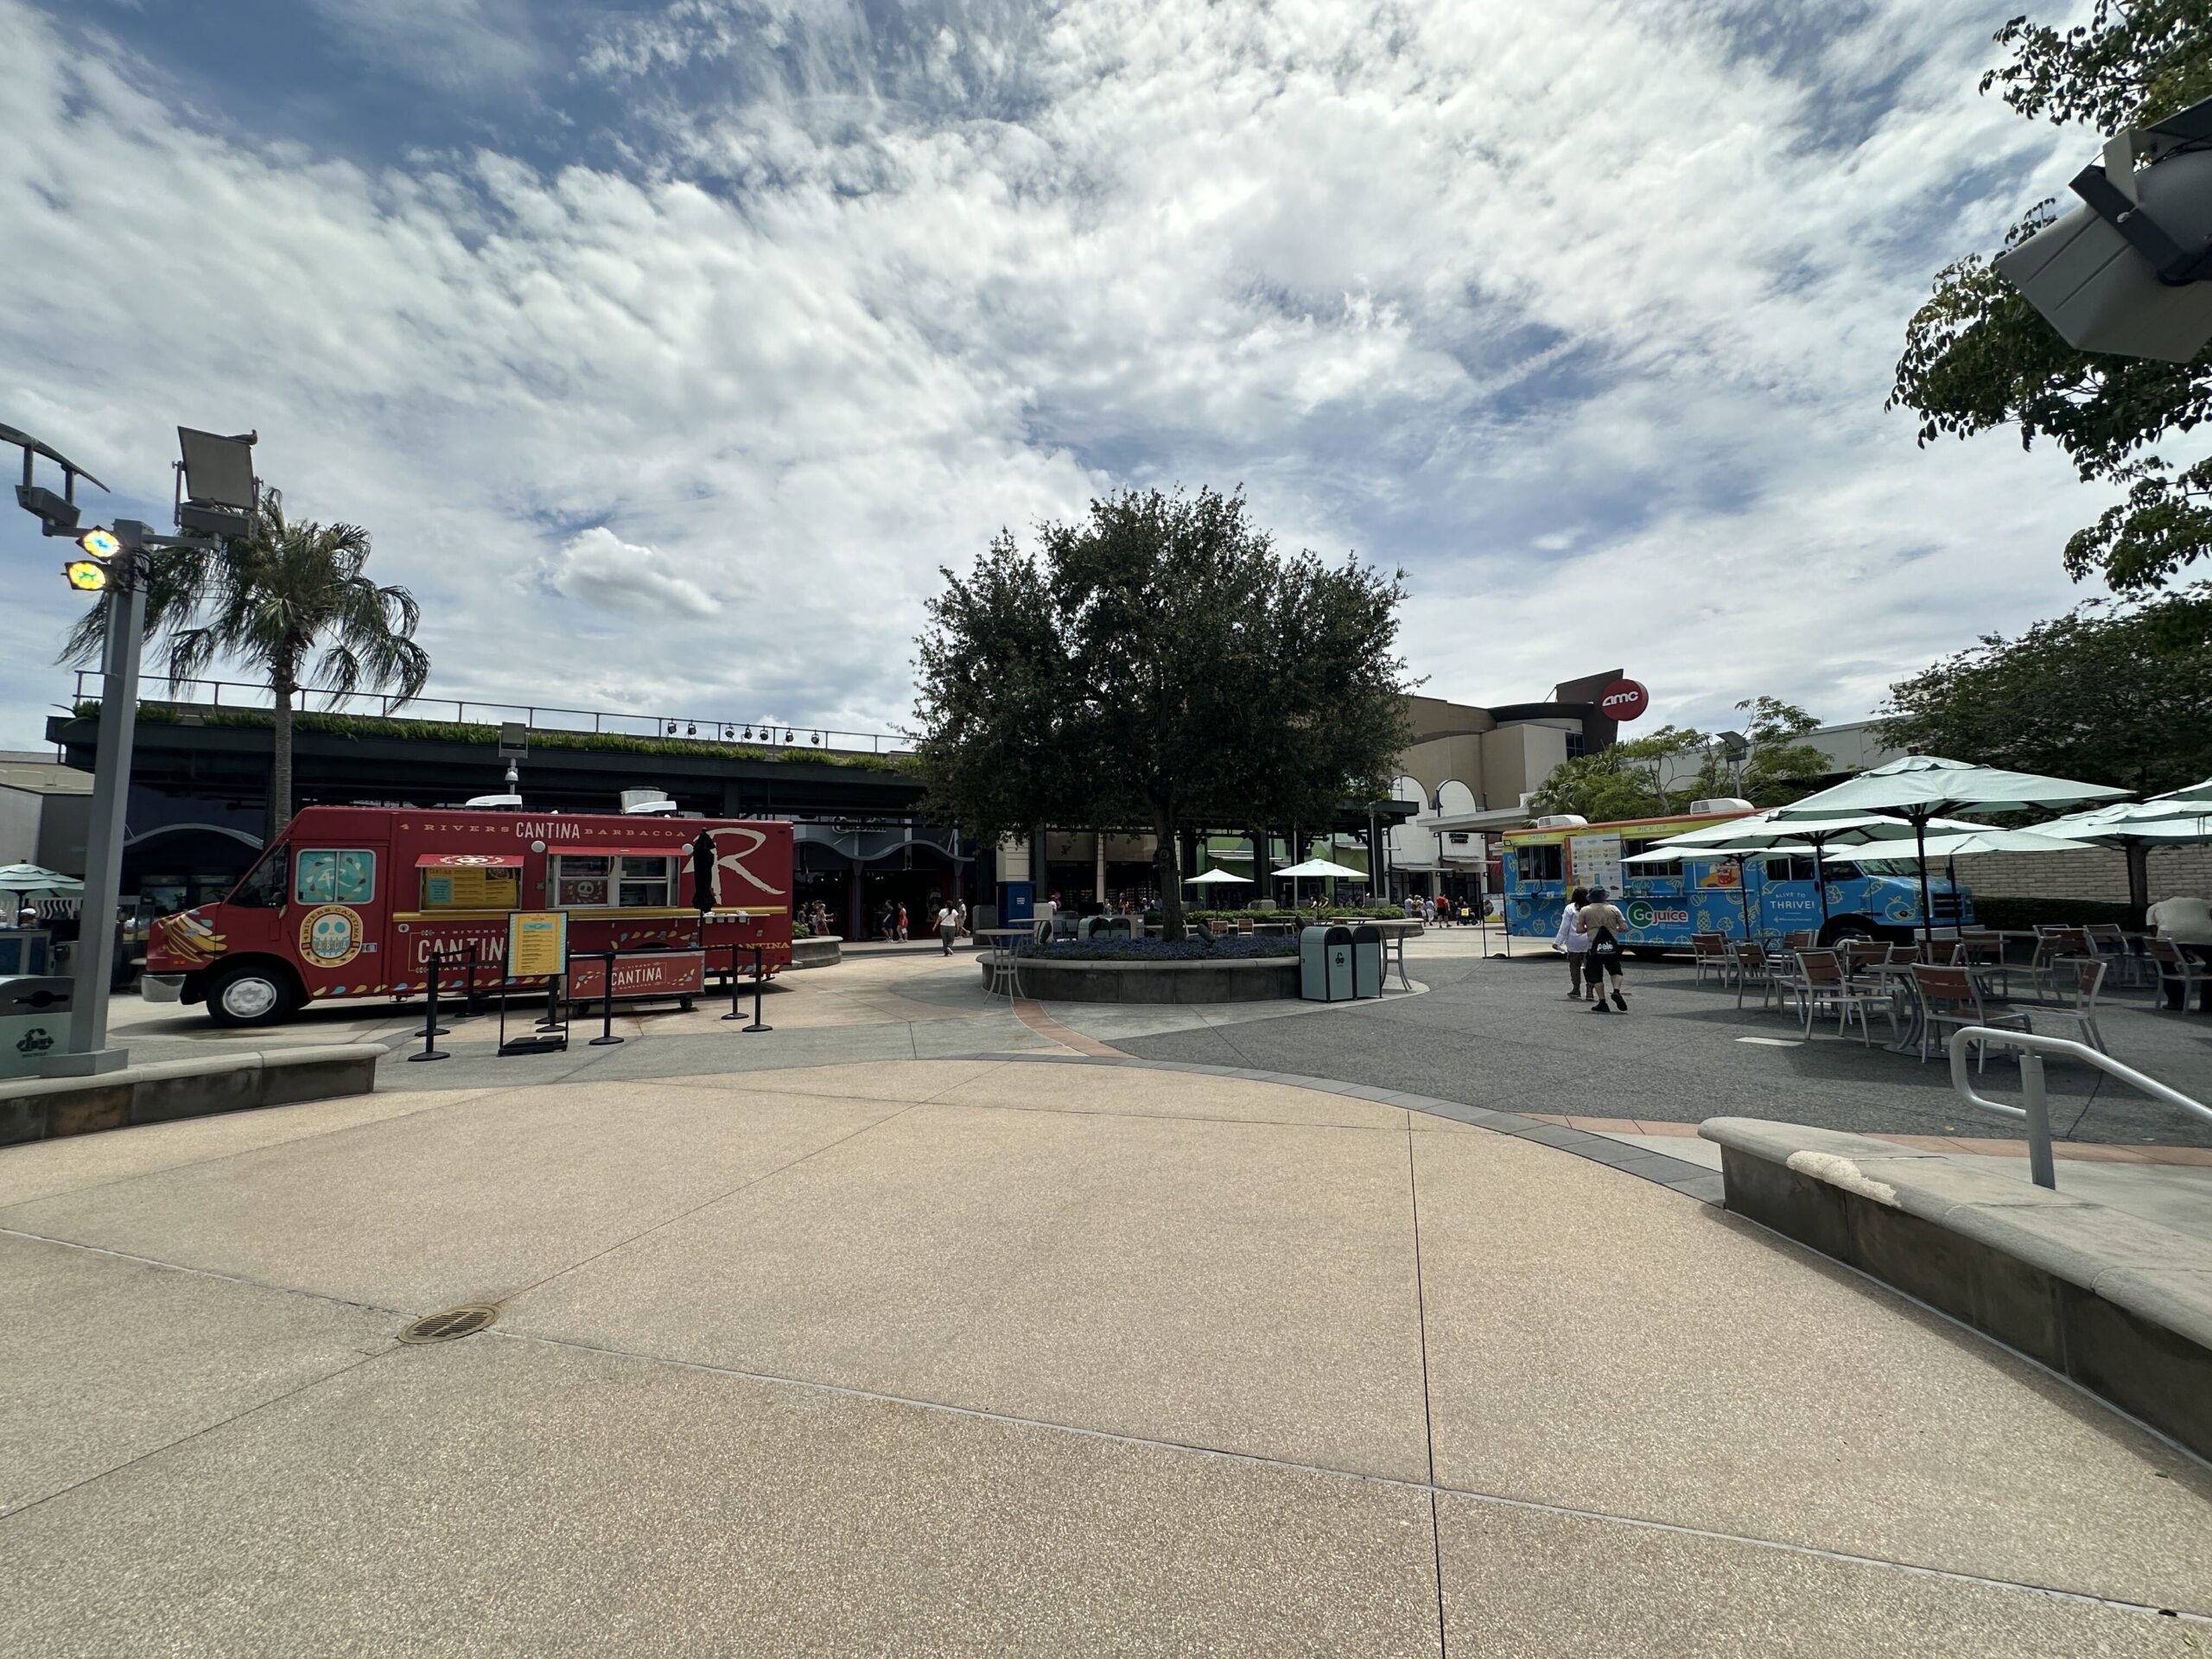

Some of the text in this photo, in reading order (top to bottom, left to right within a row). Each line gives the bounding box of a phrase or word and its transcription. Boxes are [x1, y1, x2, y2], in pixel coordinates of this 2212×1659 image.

[1602, 691, 1638, 706] amc
[516, 822, 580, 839] CANTINA
[584, 828, 686, 837] BARBACOA
[417, 937, 505, 963] CANTIN
[612, 967, 663, 986] CANTINA
